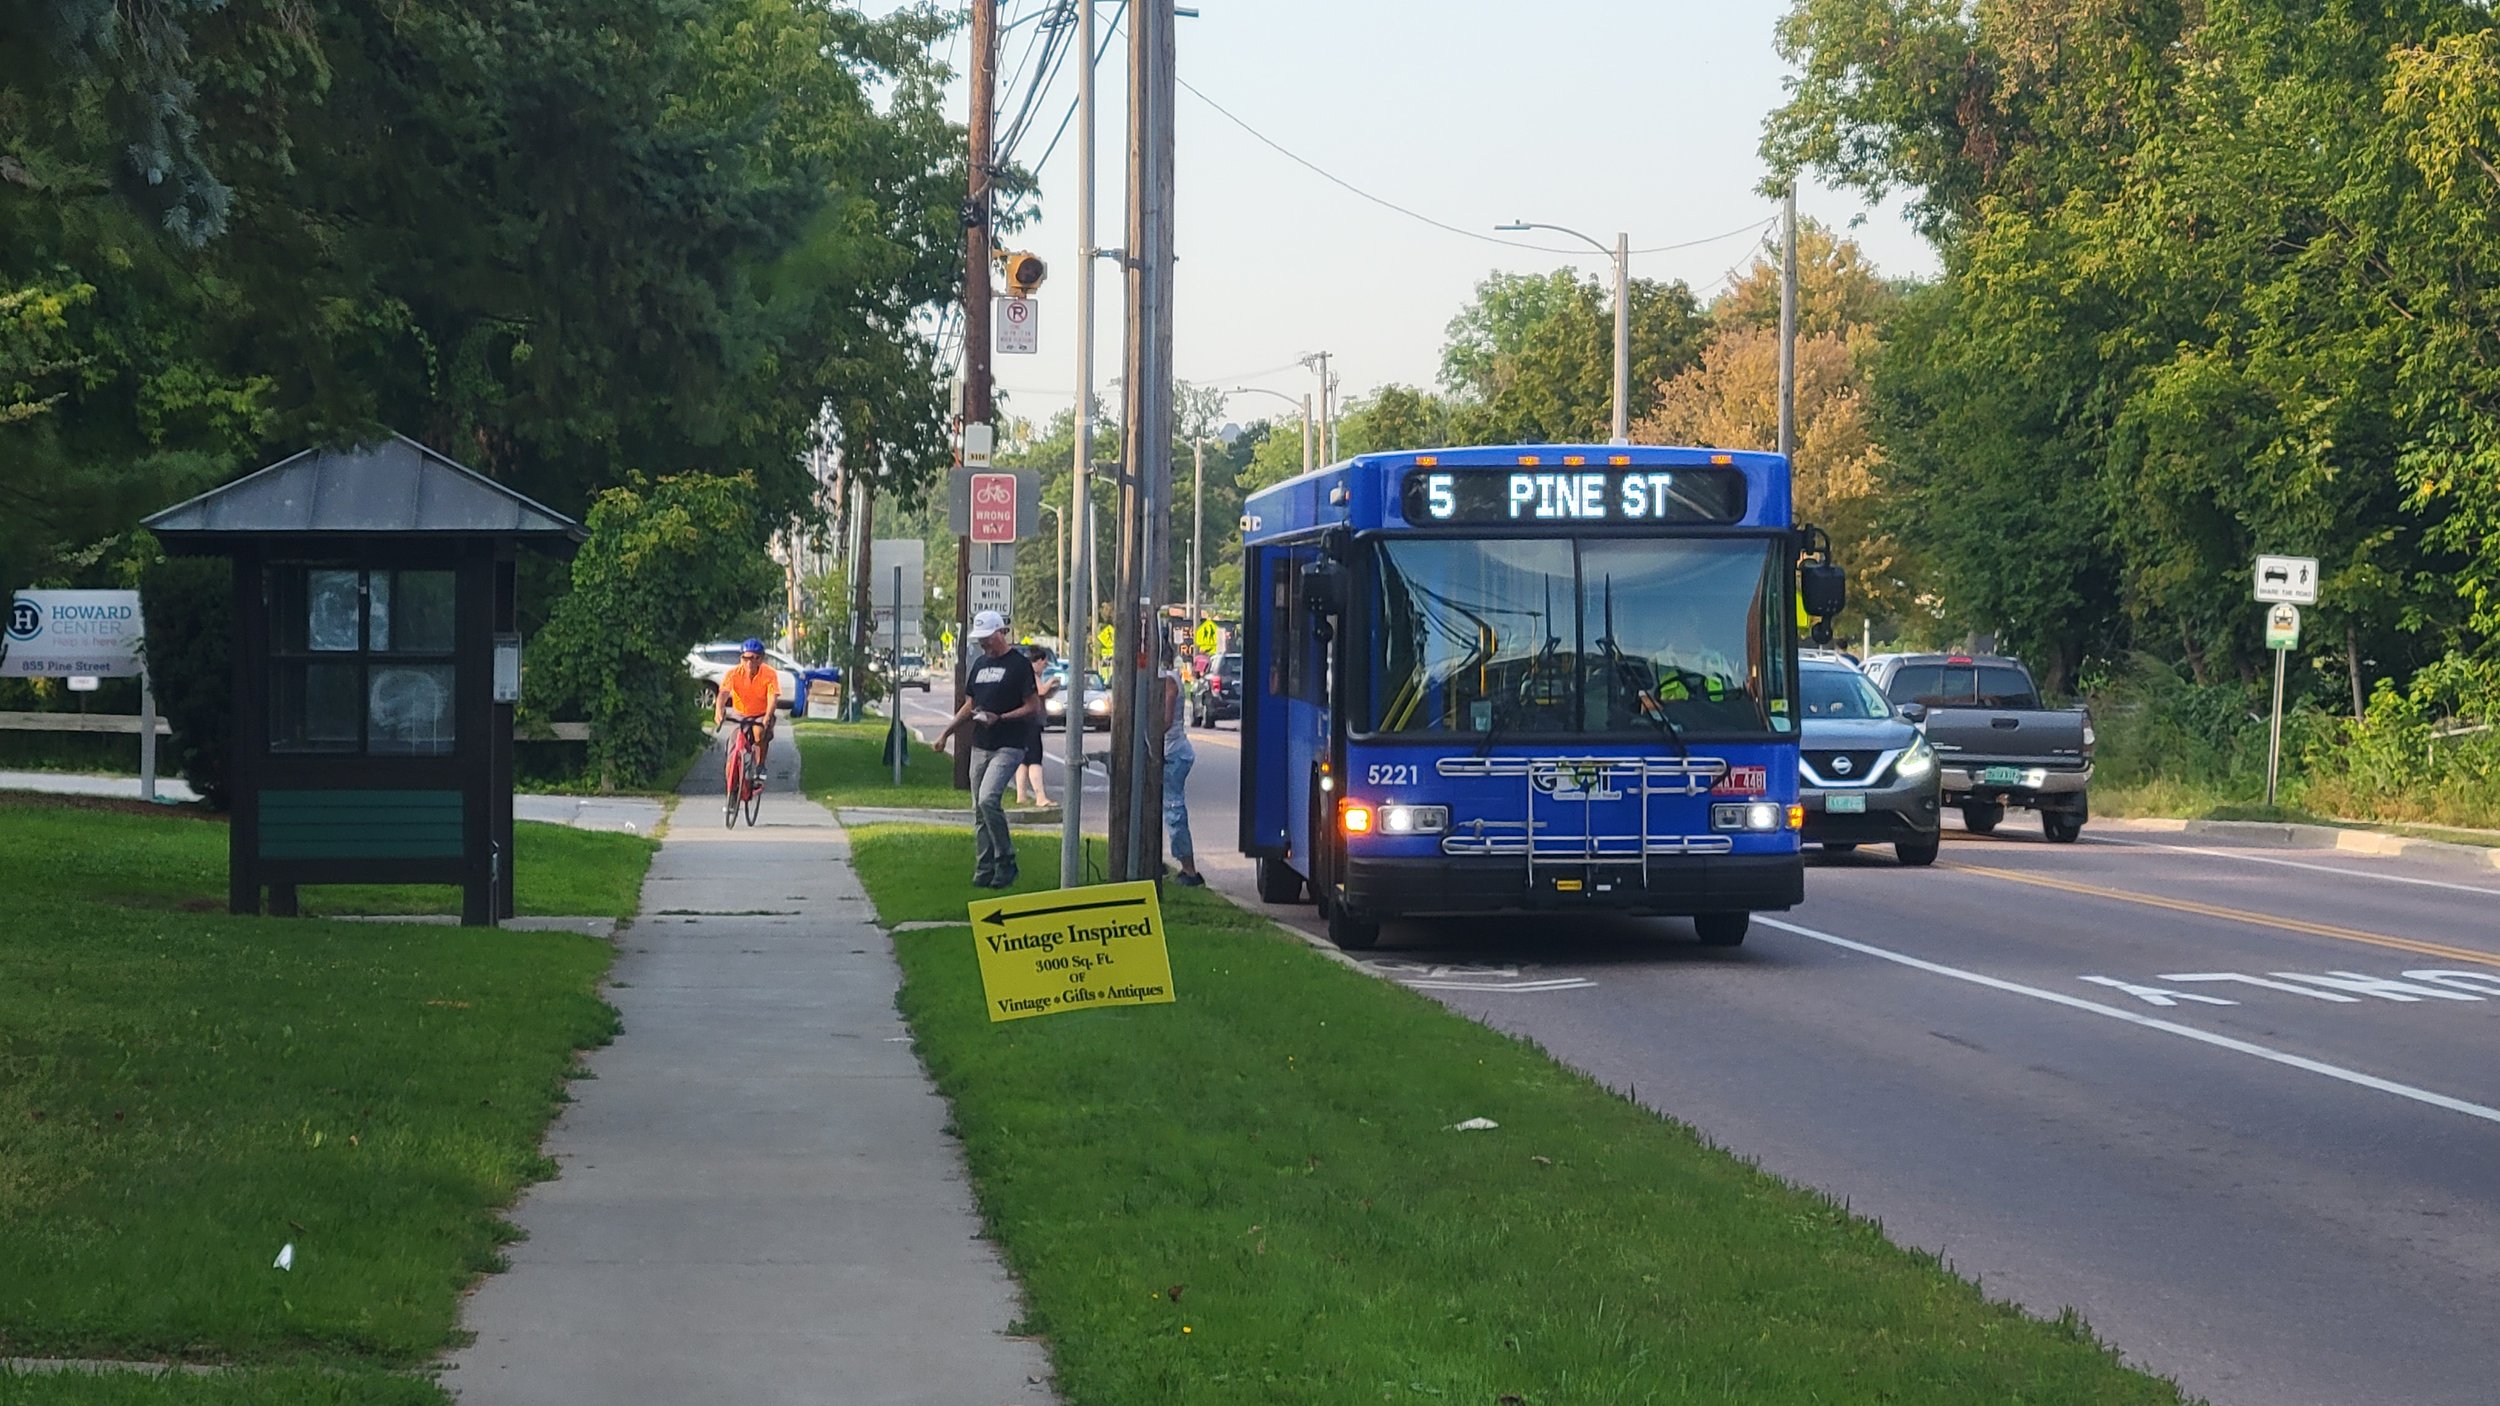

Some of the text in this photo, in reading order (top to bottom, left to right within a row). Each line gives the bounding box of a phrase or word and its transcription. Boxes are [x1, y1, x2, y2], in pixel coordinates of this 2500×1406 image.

[1428, 472, 1672, 519] 5 PINE ST
[976, 510, 1011, 521] WRONG
[982, 523, 1004, 534] WAY
[981, 577, 1001, 588] RIDE
[981, 590, 1001, 600] WITH
[52, 605, 132, 620] HOWARD
[973, 602, 1008, 613] TRAFFIC
[14, 610, 33, 630] H
[51, 620, 123, 635] CENTER
[48, 661, 73, 672] Pine
[75, 660, 111, 672] Street
[1367, 764, 1418, 785] 5221
[986, 917, 1152, 954] Vintage Inspired
[1035, 953, 1114, 973] 3000 Sq. Ft.
[1069, 972, 1086, 983] OF
[998, 983, 1163, 1012] Vintage Gifts Antiques
